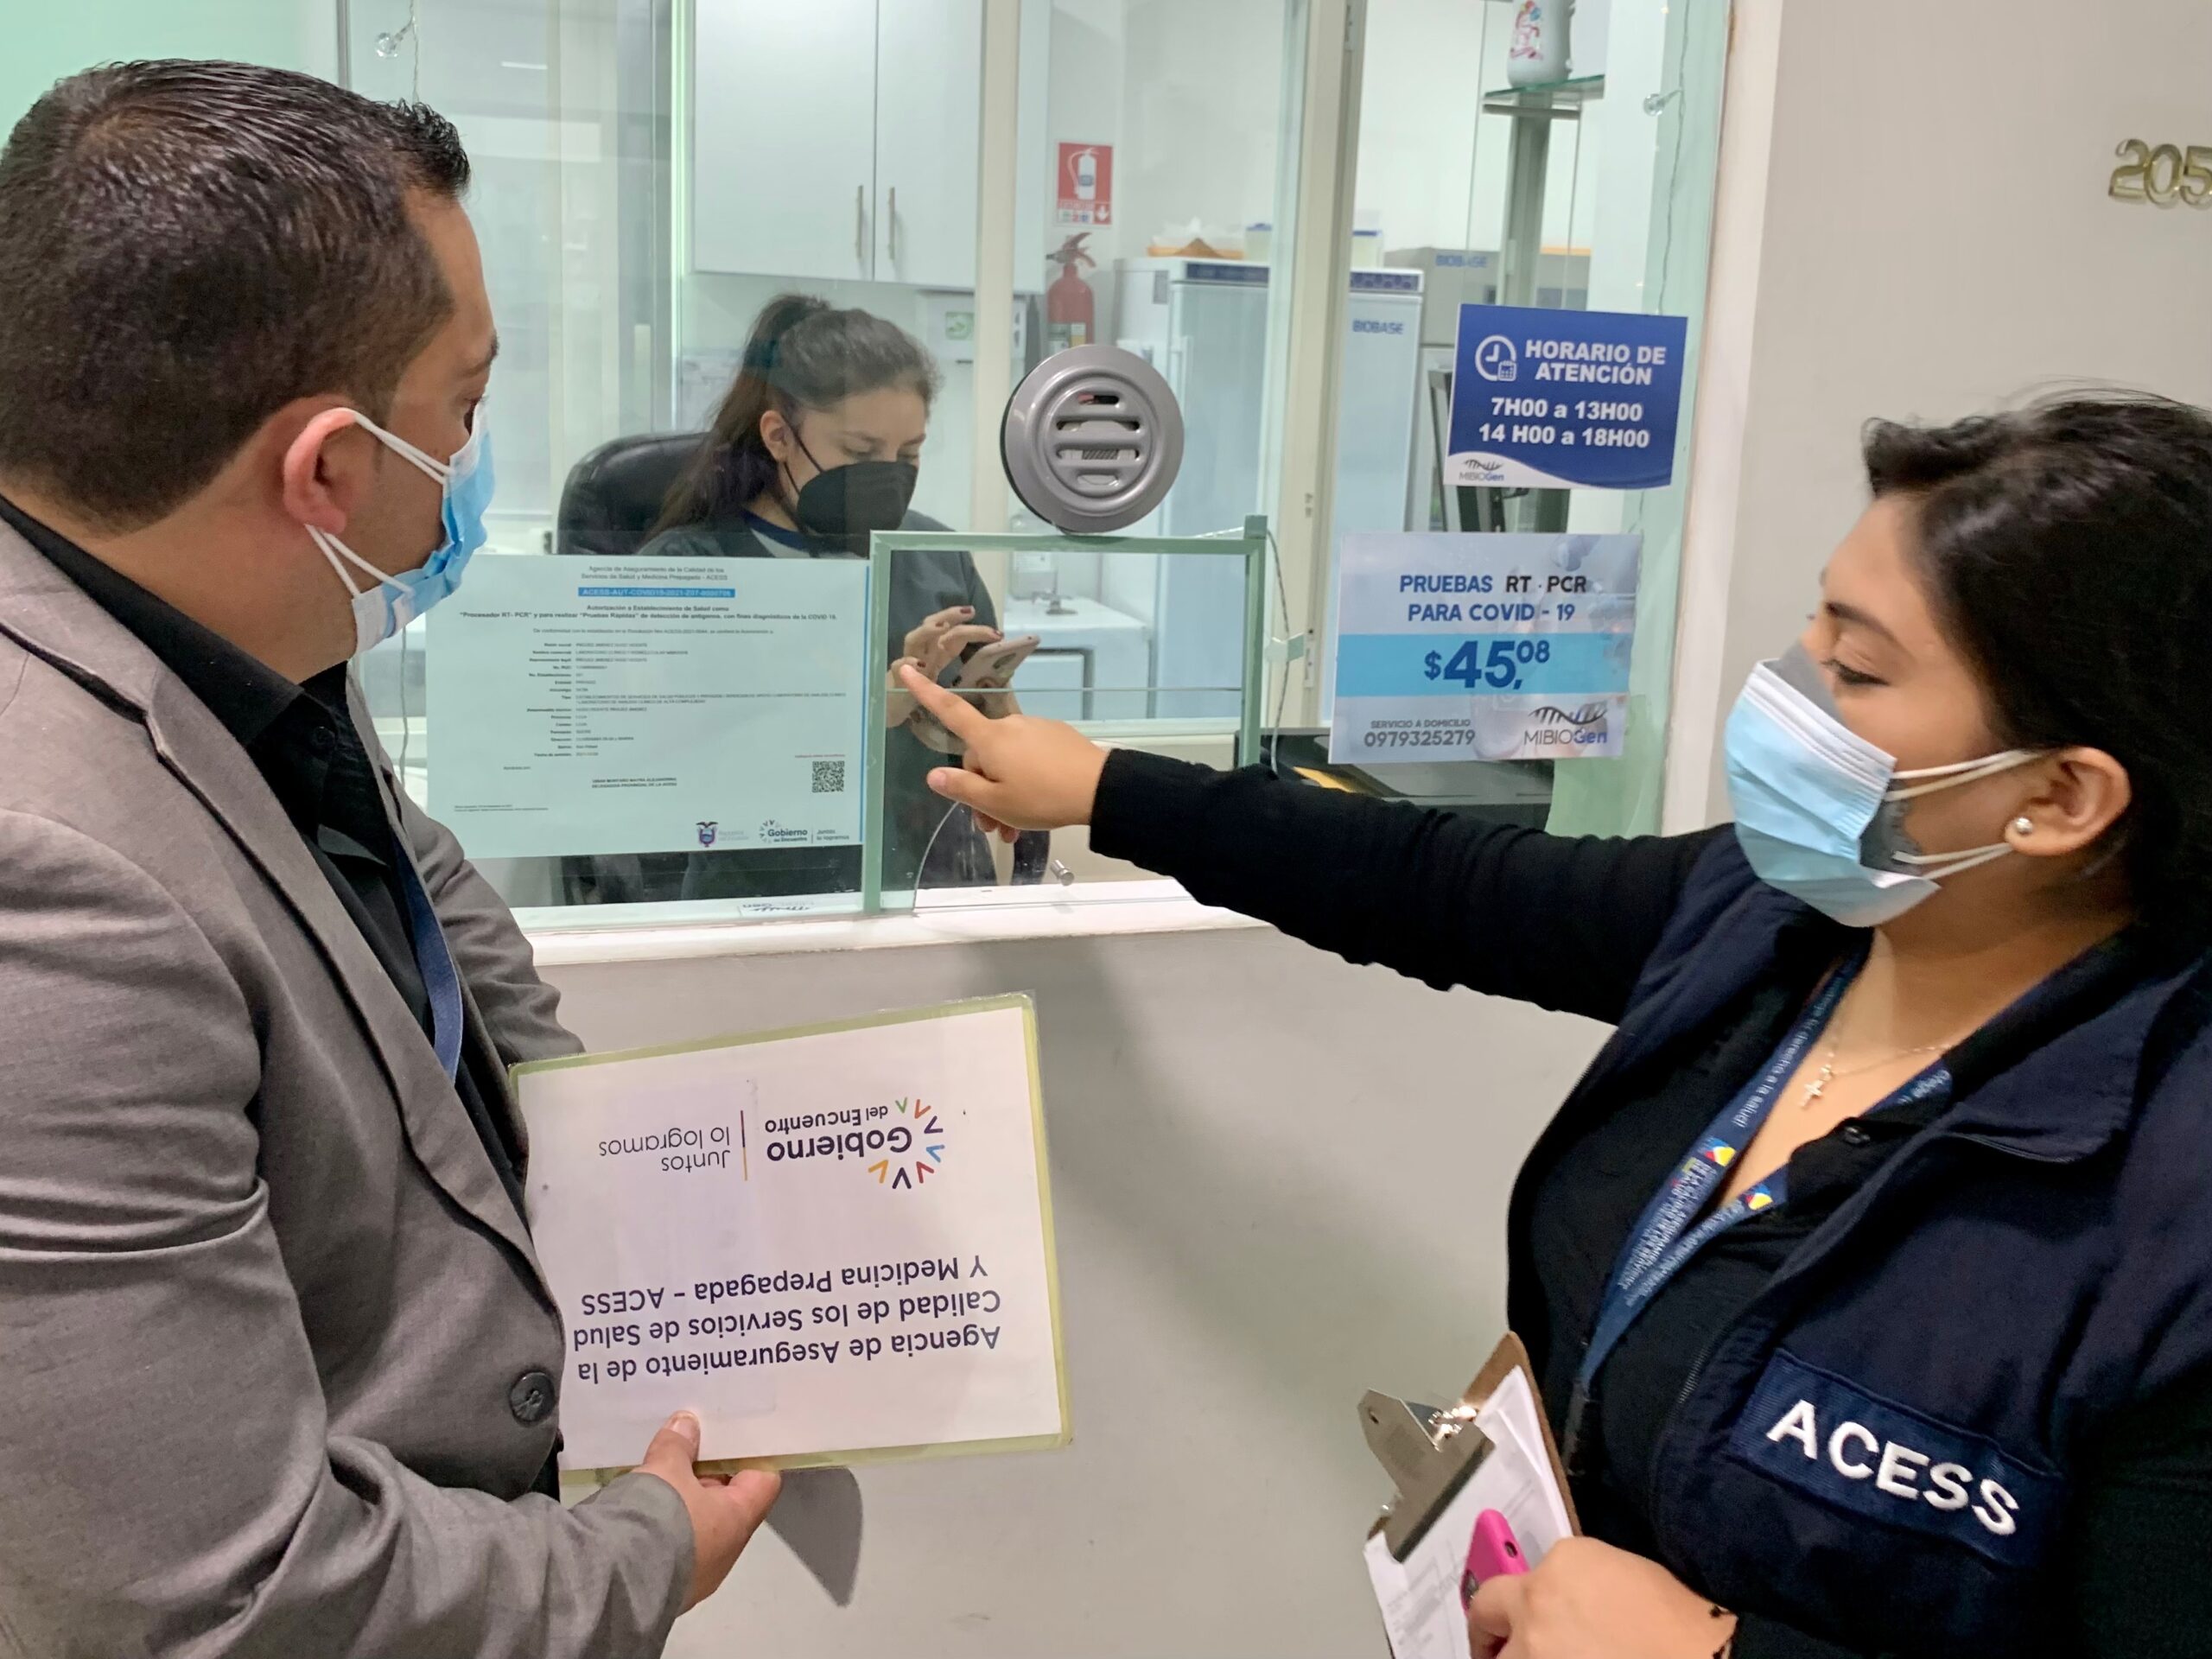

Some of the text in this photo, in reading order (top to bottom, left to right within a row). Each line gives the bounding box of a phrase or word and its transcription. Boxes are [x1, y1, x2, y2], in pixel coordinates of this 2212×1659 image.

[2108, 138, 2212, 209] 205
[1434, 253, 1488, 269] BIOBASE
[1351, 319, 1404, 335] BIOBASE
[1525, 340, 1666, 365] HORARIO DE
[1535, 363, 1652, 385] ATENCIÓN
[1491, 397, 1643, 422] 7H00 a 13H00
[1478, 423, 1650, 448] 14 H00 a 18H00
[1459, 472, 1504, 481] MIBIOGen
[1400, 575, 1493, 593] PRUEBAS
[1505, 575, 1531, 594] RT
[1546, 575, 1587, 594] PCR
[1408, 604, 1462, 621] PARA
[1469, 603, 1535, 621] COVID
[1556, 603, 1575, 621] 19
[1370, 719, 1413, 729] SERVICIO
[1424, 718, 1471, 728] DOMICILIO
[1363, 729, 1476, 748] 0979325279
[1523, 728, 1607, 746] MIBIOGen
[767, 829, 808, 837] Gobierno
[765, 1105, 889, 1135] del Encuentro
[598, 1126, 730, 1157] lo logramos
[766, 1126, 912, 1162] Gobierno
[661, 1149, 731, 1173] Juntos
[841, 1257, 959, 1288] Medicina
[969, 1255, 988, 1278] Y
[694, 1269, 832, 1305] Prepagada
[581, 1287, 665, 1316] ACESS
[573, 1289, 1001, 1352] Calidad de los Servicios de Salud
[577, 1323, 1001, 1385] Agencia de Aseguramiento de la
[1765, 1399, 2019, 1535] ACESS
